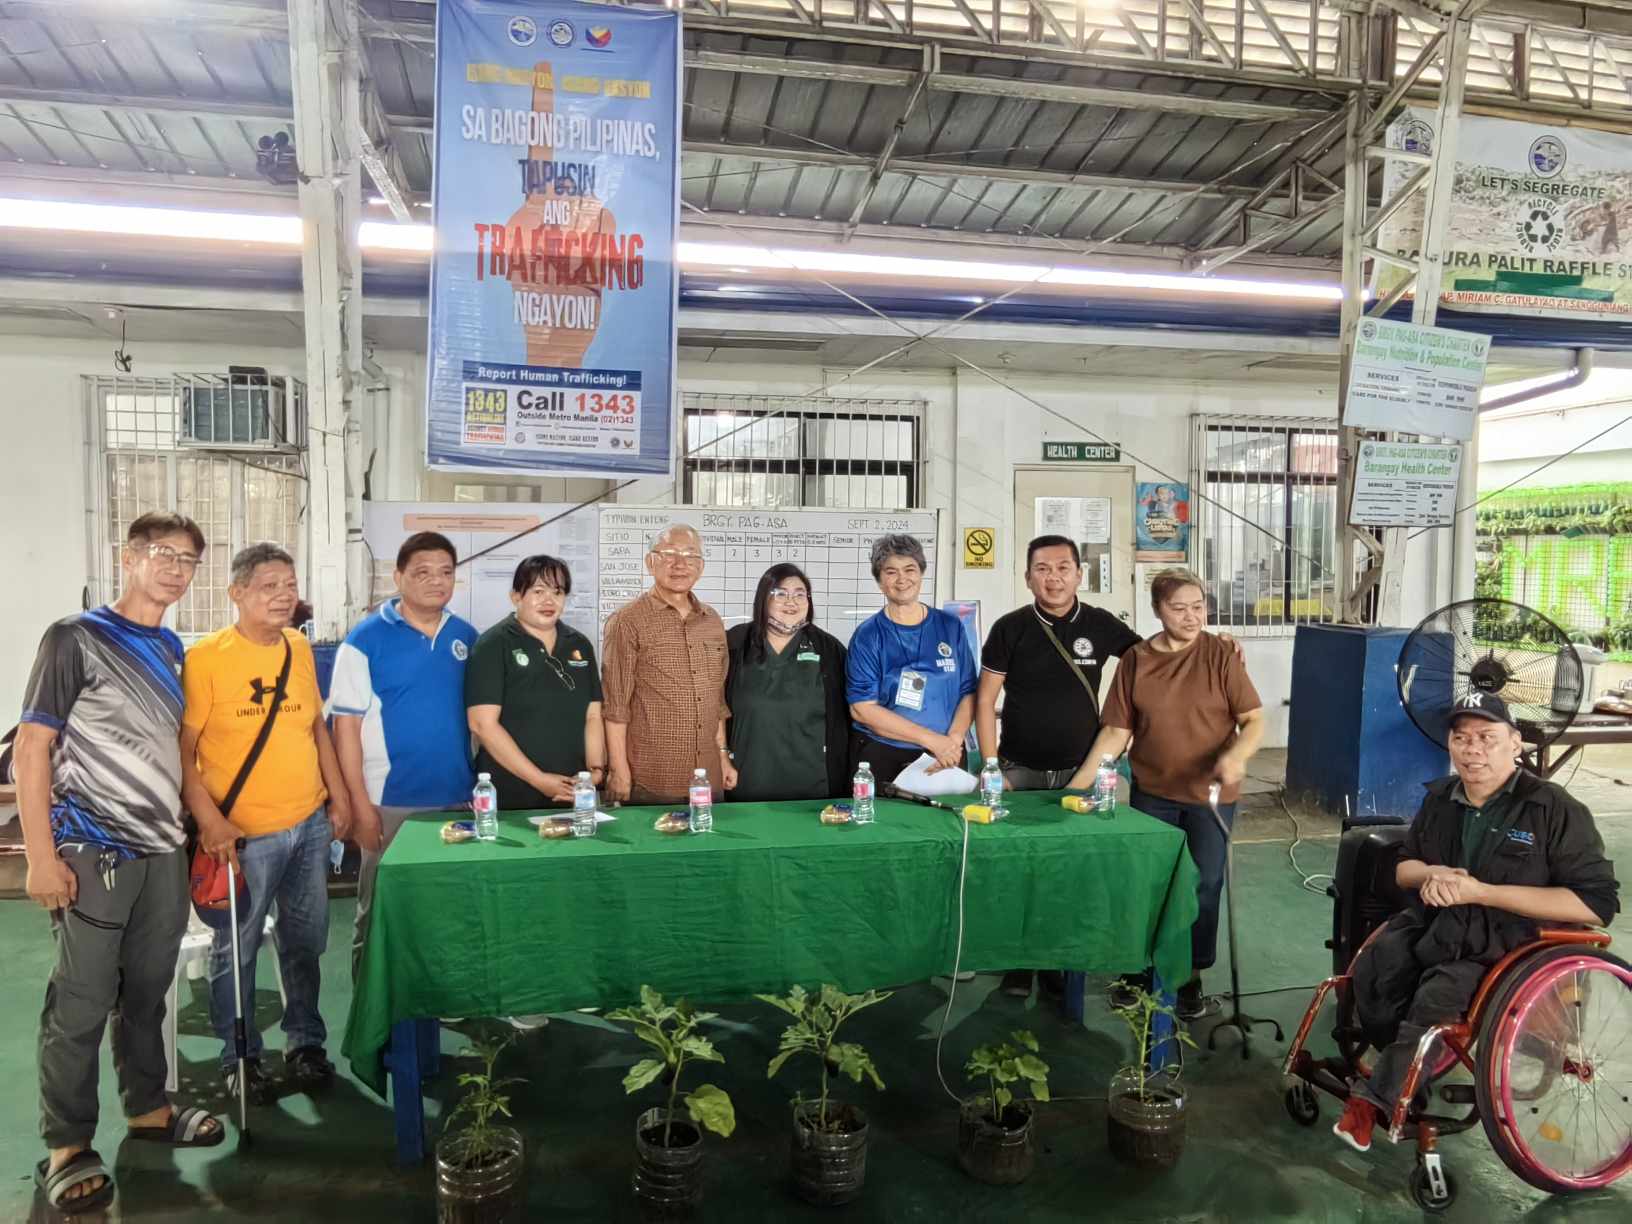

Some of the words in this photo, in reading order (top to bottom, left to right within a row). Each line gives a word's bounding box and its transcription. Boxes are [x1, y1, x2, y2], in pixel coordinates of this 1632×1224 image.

[462, 104, 486, 143] SA
[491, 108, 565, 149] BAGONG
[569, 115, 660, 161] PILIPINAS,
[518, 159, 597, 197] TAPUSIN
[1481, 175, 1519, 191] LET'S
[1523, 179, 1607, 199] SEGREGATE
[543, 200, 571, 225] ANG
[1488, 253, 1537, 273] PALIT
[1543, 258, 1614, 277] RAFFLE
[1456, 292, 1491, 304] MIRIAM
[513, 291, 596, 330] NGAYON!
[478, 367, 517, 381] Report
[520, 370, 559, 382] Human
[563, 372, 627, 388] Trafficking!
[467, 390, 506, 413] 1343
[516, 390, 565, 412] Call
[576, 393, 636, 415] 1343
[549, 413, 572, 422] Metro
[573, 415, 599, 423] Manila
[1047, 444, 1078, 458] HEALTH
[1085, 446, 1116, 459] CENTER
[1401, 462, 1426, 474] Health
[1427, 463, 1452, 475] Center
[886, 520, 909, 530] 2024
[236, 706, 266, 717] UNDER
